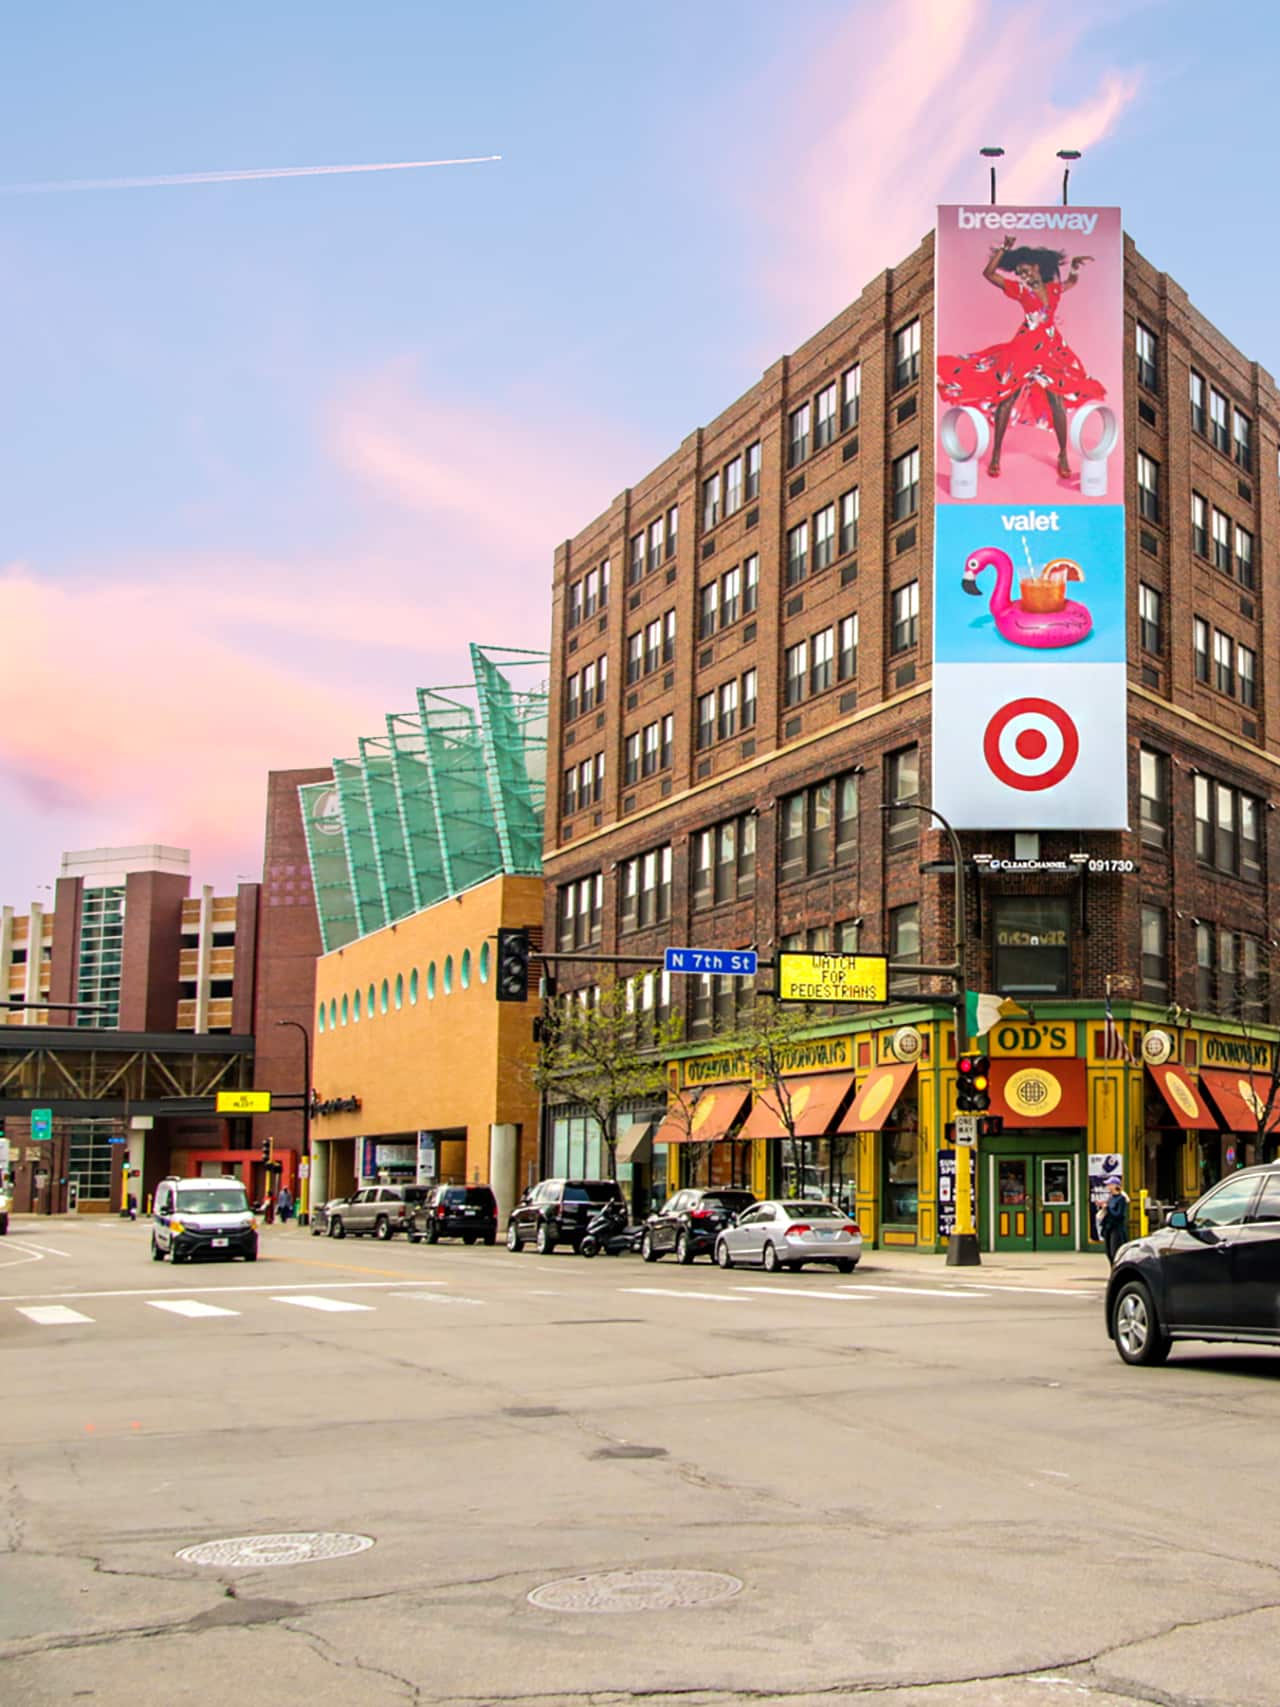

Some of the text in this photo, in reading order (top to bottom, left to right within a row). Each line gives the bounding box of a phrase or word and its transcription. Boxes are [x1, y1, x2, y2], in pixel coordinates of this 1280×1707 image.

[957, 207, 1098, 235] breezeway
[1001, 511, 1060, 531] valet
[1088, 860, 1133, 871] 091730
[672, 953, 750, 970] N 7th St
[812, 955, 856, 970] WATCH
[821, 970, 846, 983] FOR
[790, 984, 877, 999] PEDESTRIANS
[998, 1026, 1067, 1051] OD'S
